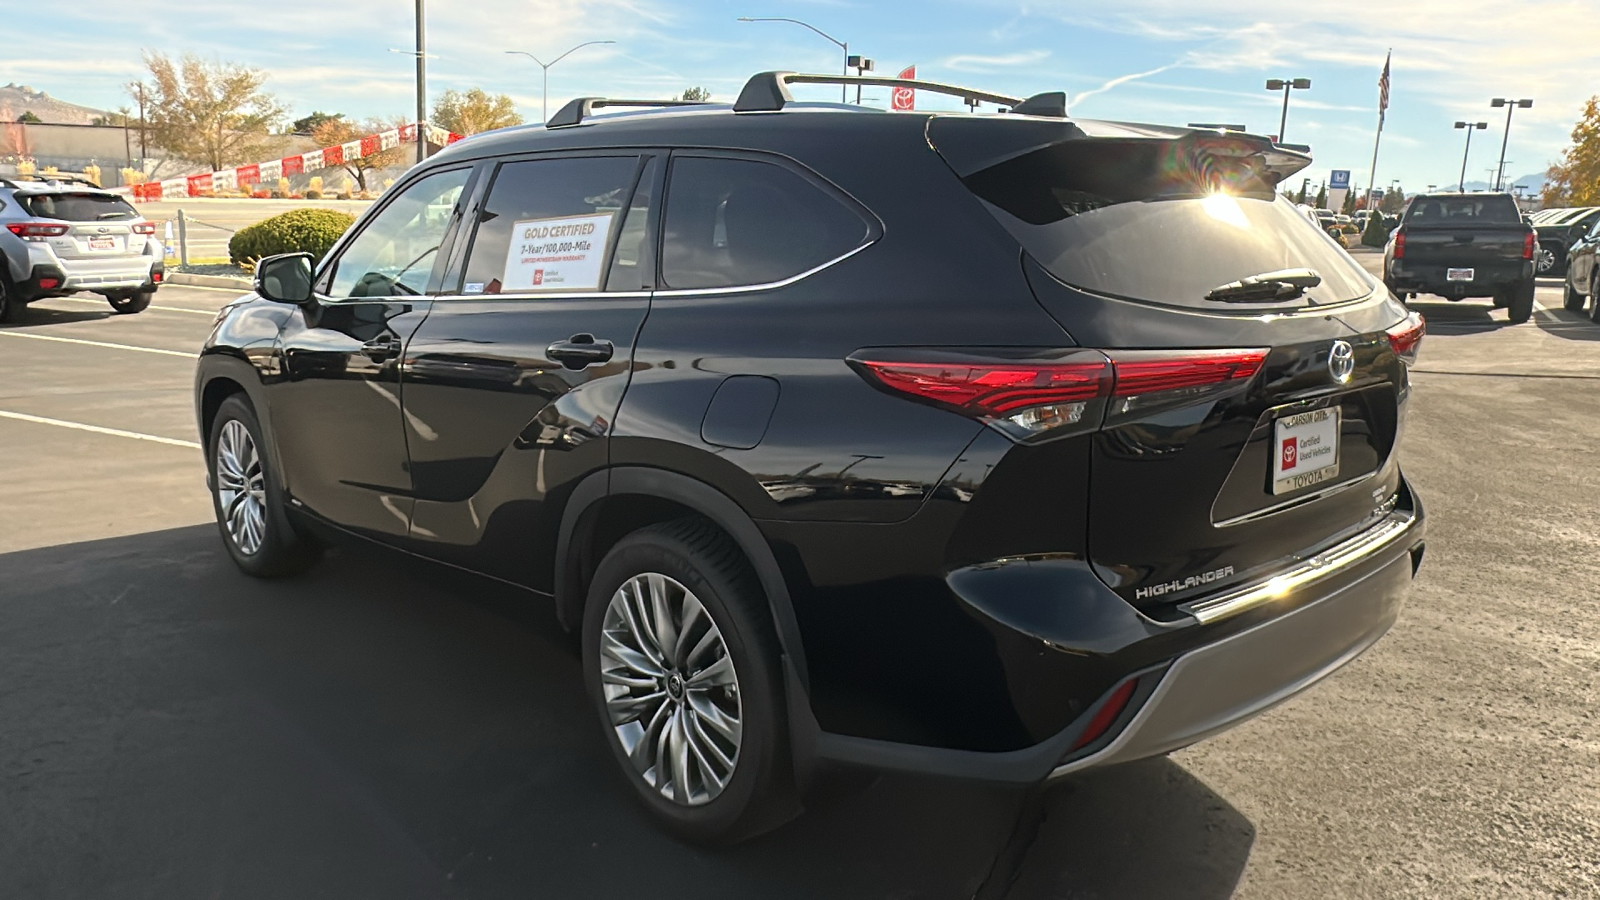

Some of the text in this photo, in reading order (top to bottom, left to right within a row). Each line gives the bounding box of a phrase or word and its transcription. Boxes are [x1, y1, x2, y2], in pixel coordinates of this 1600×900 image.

[525, 223, 595, 239] GOLD CERTIFIED
[521, 240, 591, 254] 7-Year/100,000-Mile
[1291, 413, 1313, 426] CARSON
[1300, 435, 1320, 448] Certified
[1300, 446, 1331, 461] Used Vehicles
[1293, 471, 1323, 488] TOYOTA
[1136, 565, 1234, 599] HIGHLANDER
